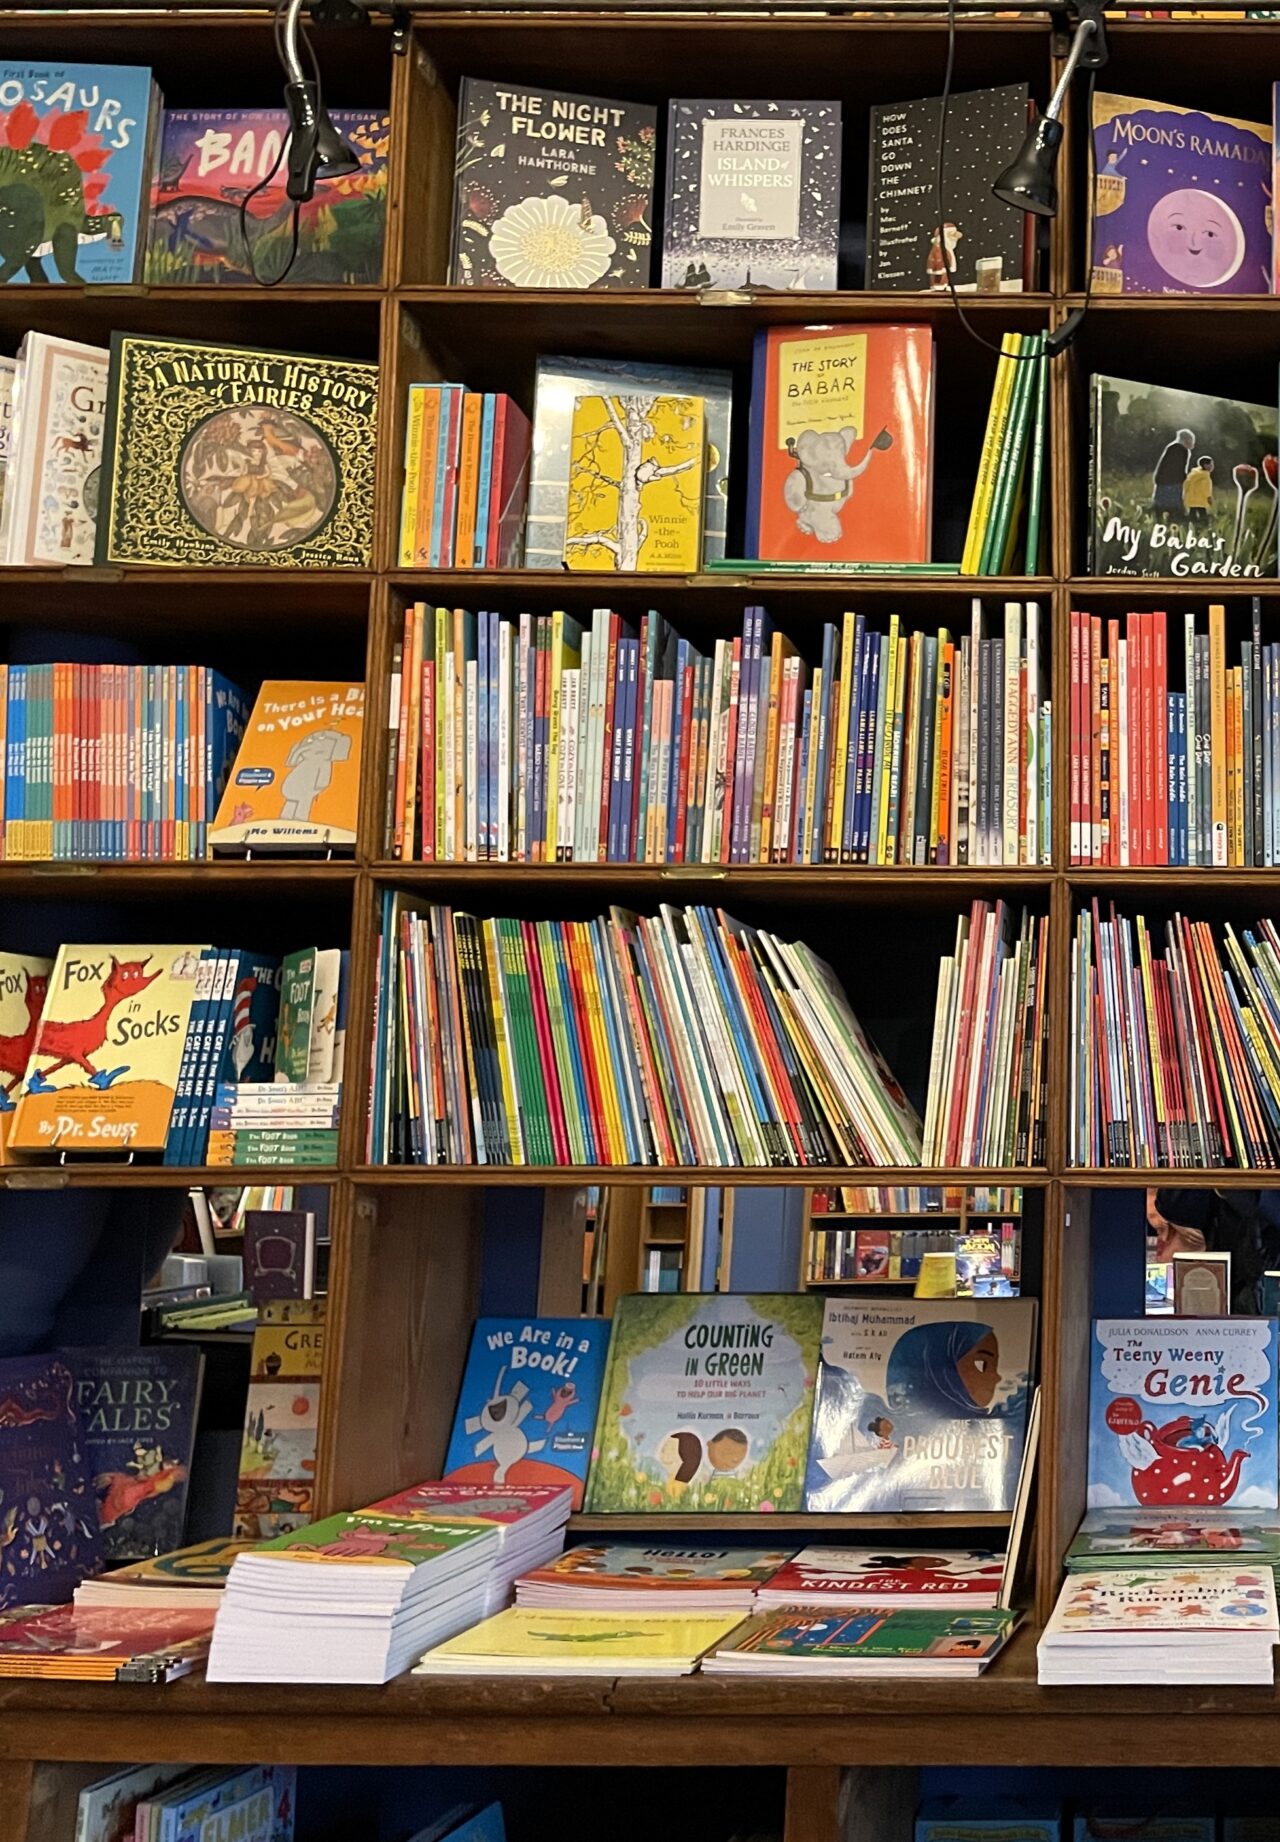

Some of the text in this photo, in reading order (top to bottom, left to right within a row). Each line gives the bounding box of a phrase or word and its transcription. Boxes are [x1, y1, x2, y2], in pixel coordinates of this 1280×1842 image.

[0, 79, 136, 149] OSAURS
[496, 91, 626, 127] THE NIGHT
[882, 112, 908, 124] HOW
[511, 116, 606, 147] FLOWER
[721, 127, 785, 139] FRANCES
[881, 124, 908, 136] DOES
[713, 140, 791, 152] HARDINGE
[881, 136, 914, 149] SANTA
[1190, 135, 1271, 167] RAMADA
[541, 146, 575, 160] LARA
[881, 151, 896, 161] GO
[518, 155, 598, 176] HAWTHORNE
[717, 157, 781, 171] ISLAND
[880, 162, 912, 174] DOWN
[707, 173, 794, 188] WHISPERS
[880, 175, 900, 186] THE
[879, 184, 934, 200] CHIMNEY?
[879, 235, 918, 247] illustrated
[877, 270, 906, 280] Klassen
[792, 356, 858, 373] THE STORY
[155, 369, 167, 390] A
[787, 377, 856, 398] BABAR
[230, 380, 314, 411] FAIRIES
[407, 409, 421, 494] Winnie-the-Pooh
[649, 514, 688, 525] Winnie
[142, 537, 216, 550] Emily Hawkins
[654, 540, 680, 550] Pooh
[1103, 517, 1226, 561] My Baba's
[1170, 552, 1264, 578] Garden
[263, 700, 306, 714] There
[330, 693, 340, 702] a
[257, 702, 365, 733] on Your Hea
[746, 711, 755, 762] CLOUD BABIES
[1006, 656, 1019, 831] THE RAGGEDY ANN TREASURY
[624, 728, 633, 781] WHAT ROUND?
[250, 827, 319, 836] Mo Willems
[252, 965, 274, 985] THE
[290, 980, 311, 1004] FOOT
[128, 1000, 141, 1013] in
[112, 1010, 180, 1046] Socks
[194, 1019, 215, 1097] THE CAT THE HAT
[205, 1019, 226, 1097] THE CAT THE HAT
[38, 1114, 139, 1138] By Dr. Seuss
[828, 1312, 916, 1325] Ibtihaj Muhammad
[487, 1325, 590, 1353] We Are in a
[1108, 1327, 1189, 1338] JULIA DONALDSON
[1195, 1327, 1258, 1337] ANNA CURREY
[1127, 1339, 1143, 1348] The
[511, 1346, 579, 1378] Book!
[1113, 1348, 1225, 1366] Teeny Weeny
[705, 1379, 752, 1388] LITTLE WAYS
[1144, 1365, 1249, 1398] Genie
[77, 1379, 178, 1406] FAIRY
[739, 1390, 767, 1398] PLANET
[800, 1578, 969, 1592] KINDEST RED
